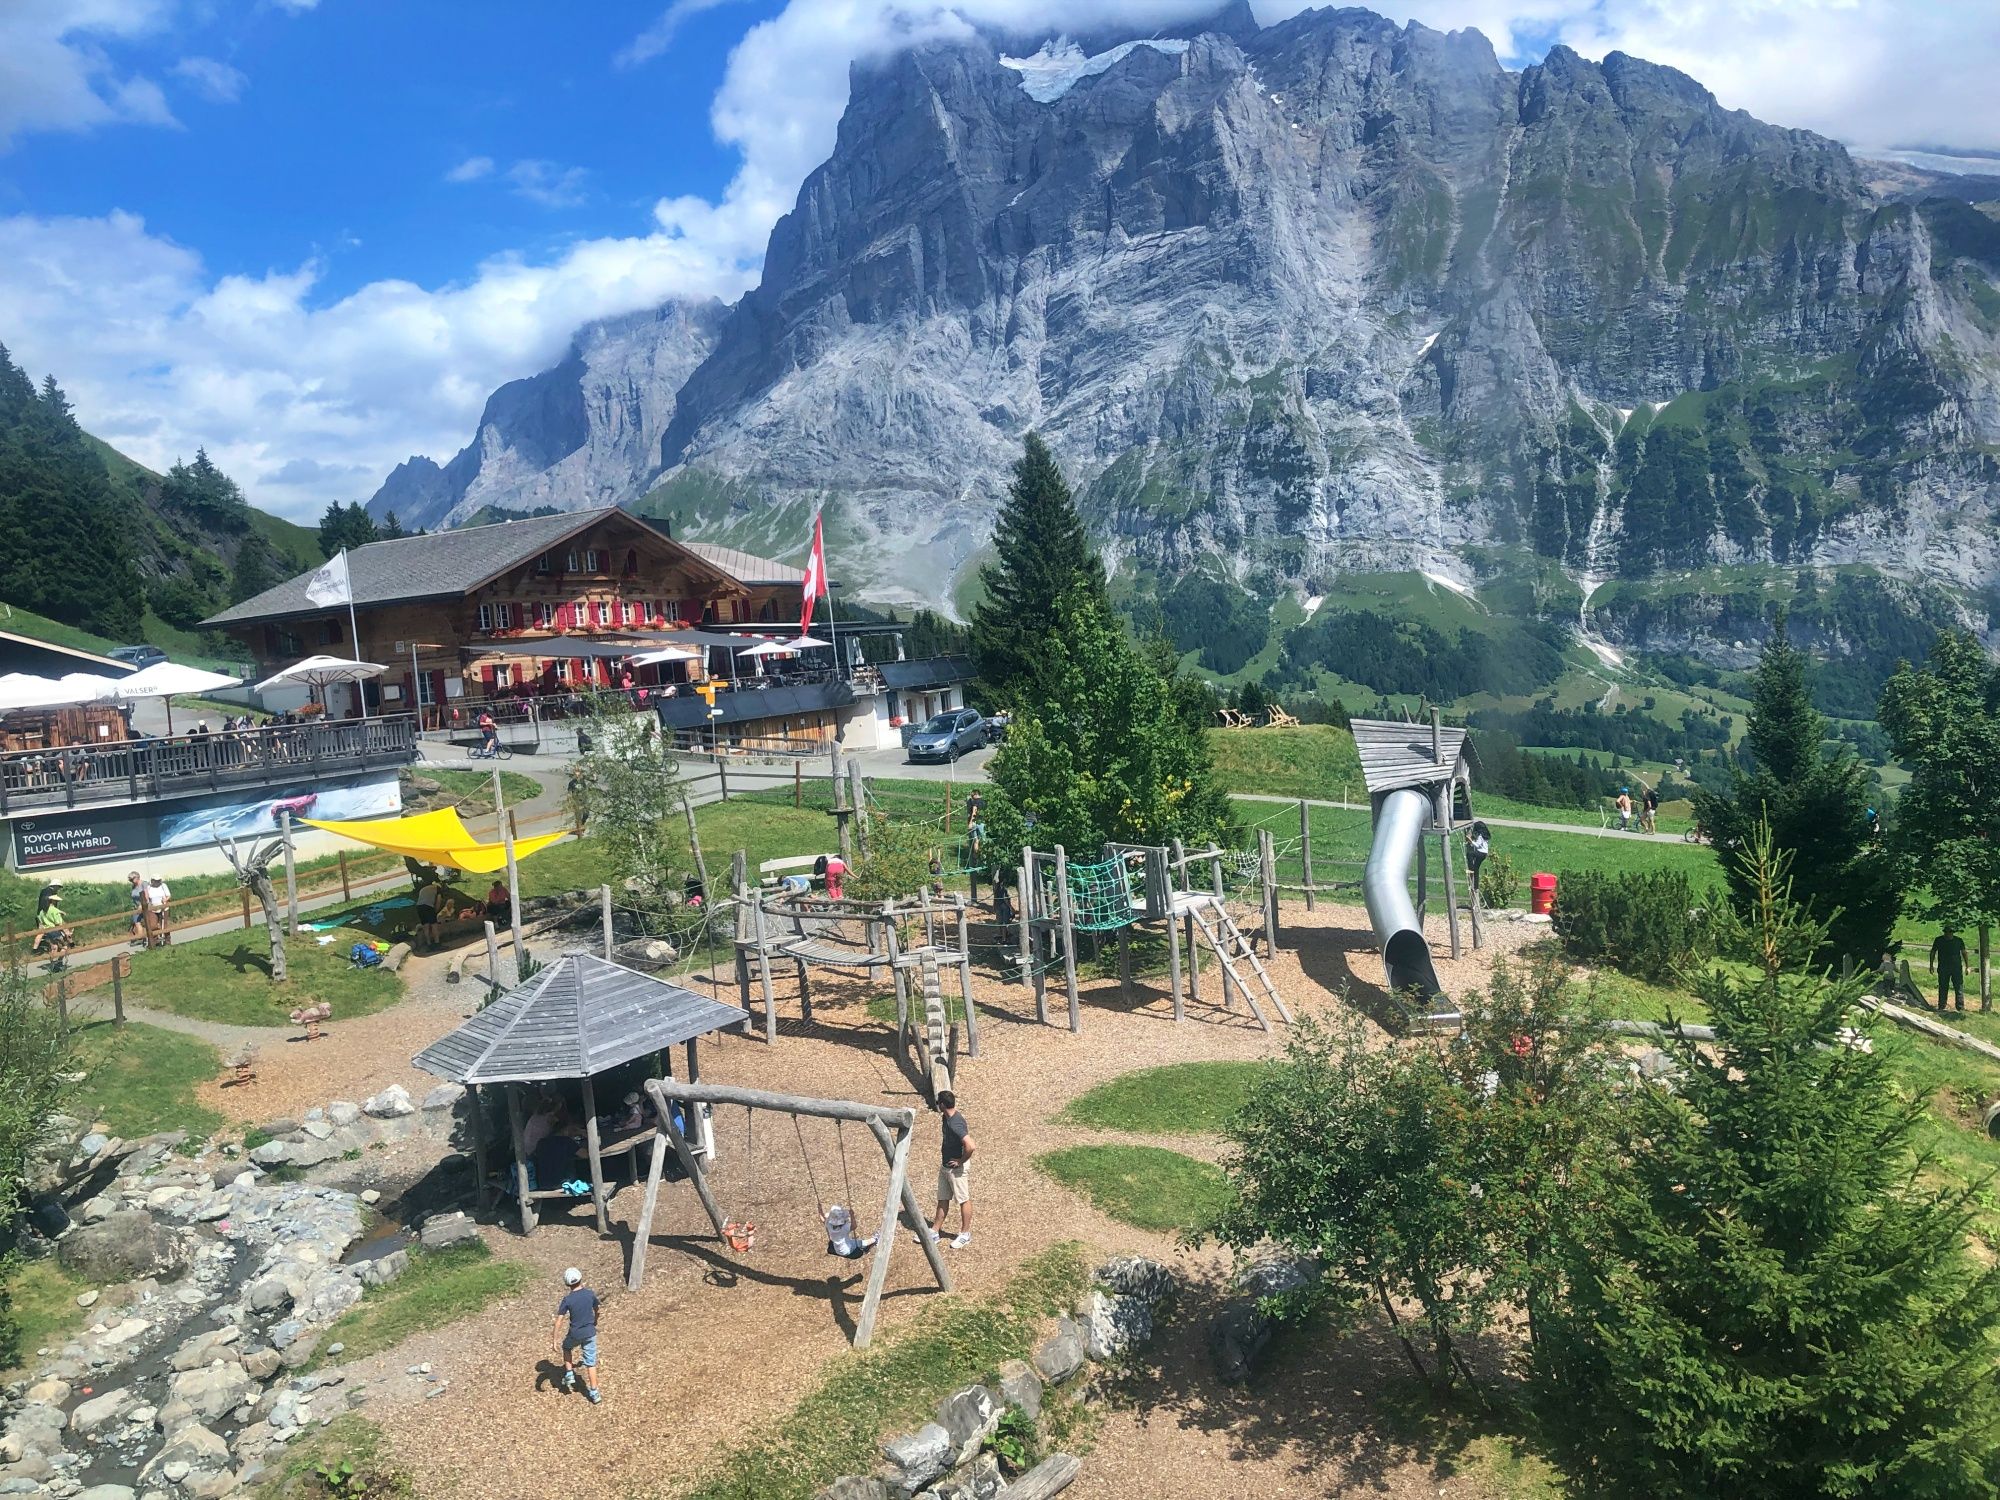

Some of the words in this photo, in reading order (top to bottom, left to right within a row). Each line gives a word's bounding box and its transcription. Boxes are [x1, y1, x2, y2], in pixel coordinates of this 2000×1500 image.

[124, 687, 154, 695] VALSER
[22, 832, 64, 844] TOYOTA
[66, 828, 92, 839] RAV4
[24, 842, 69, 855] PLUG-IN
[71, 836, 111, 850] HYBRID
